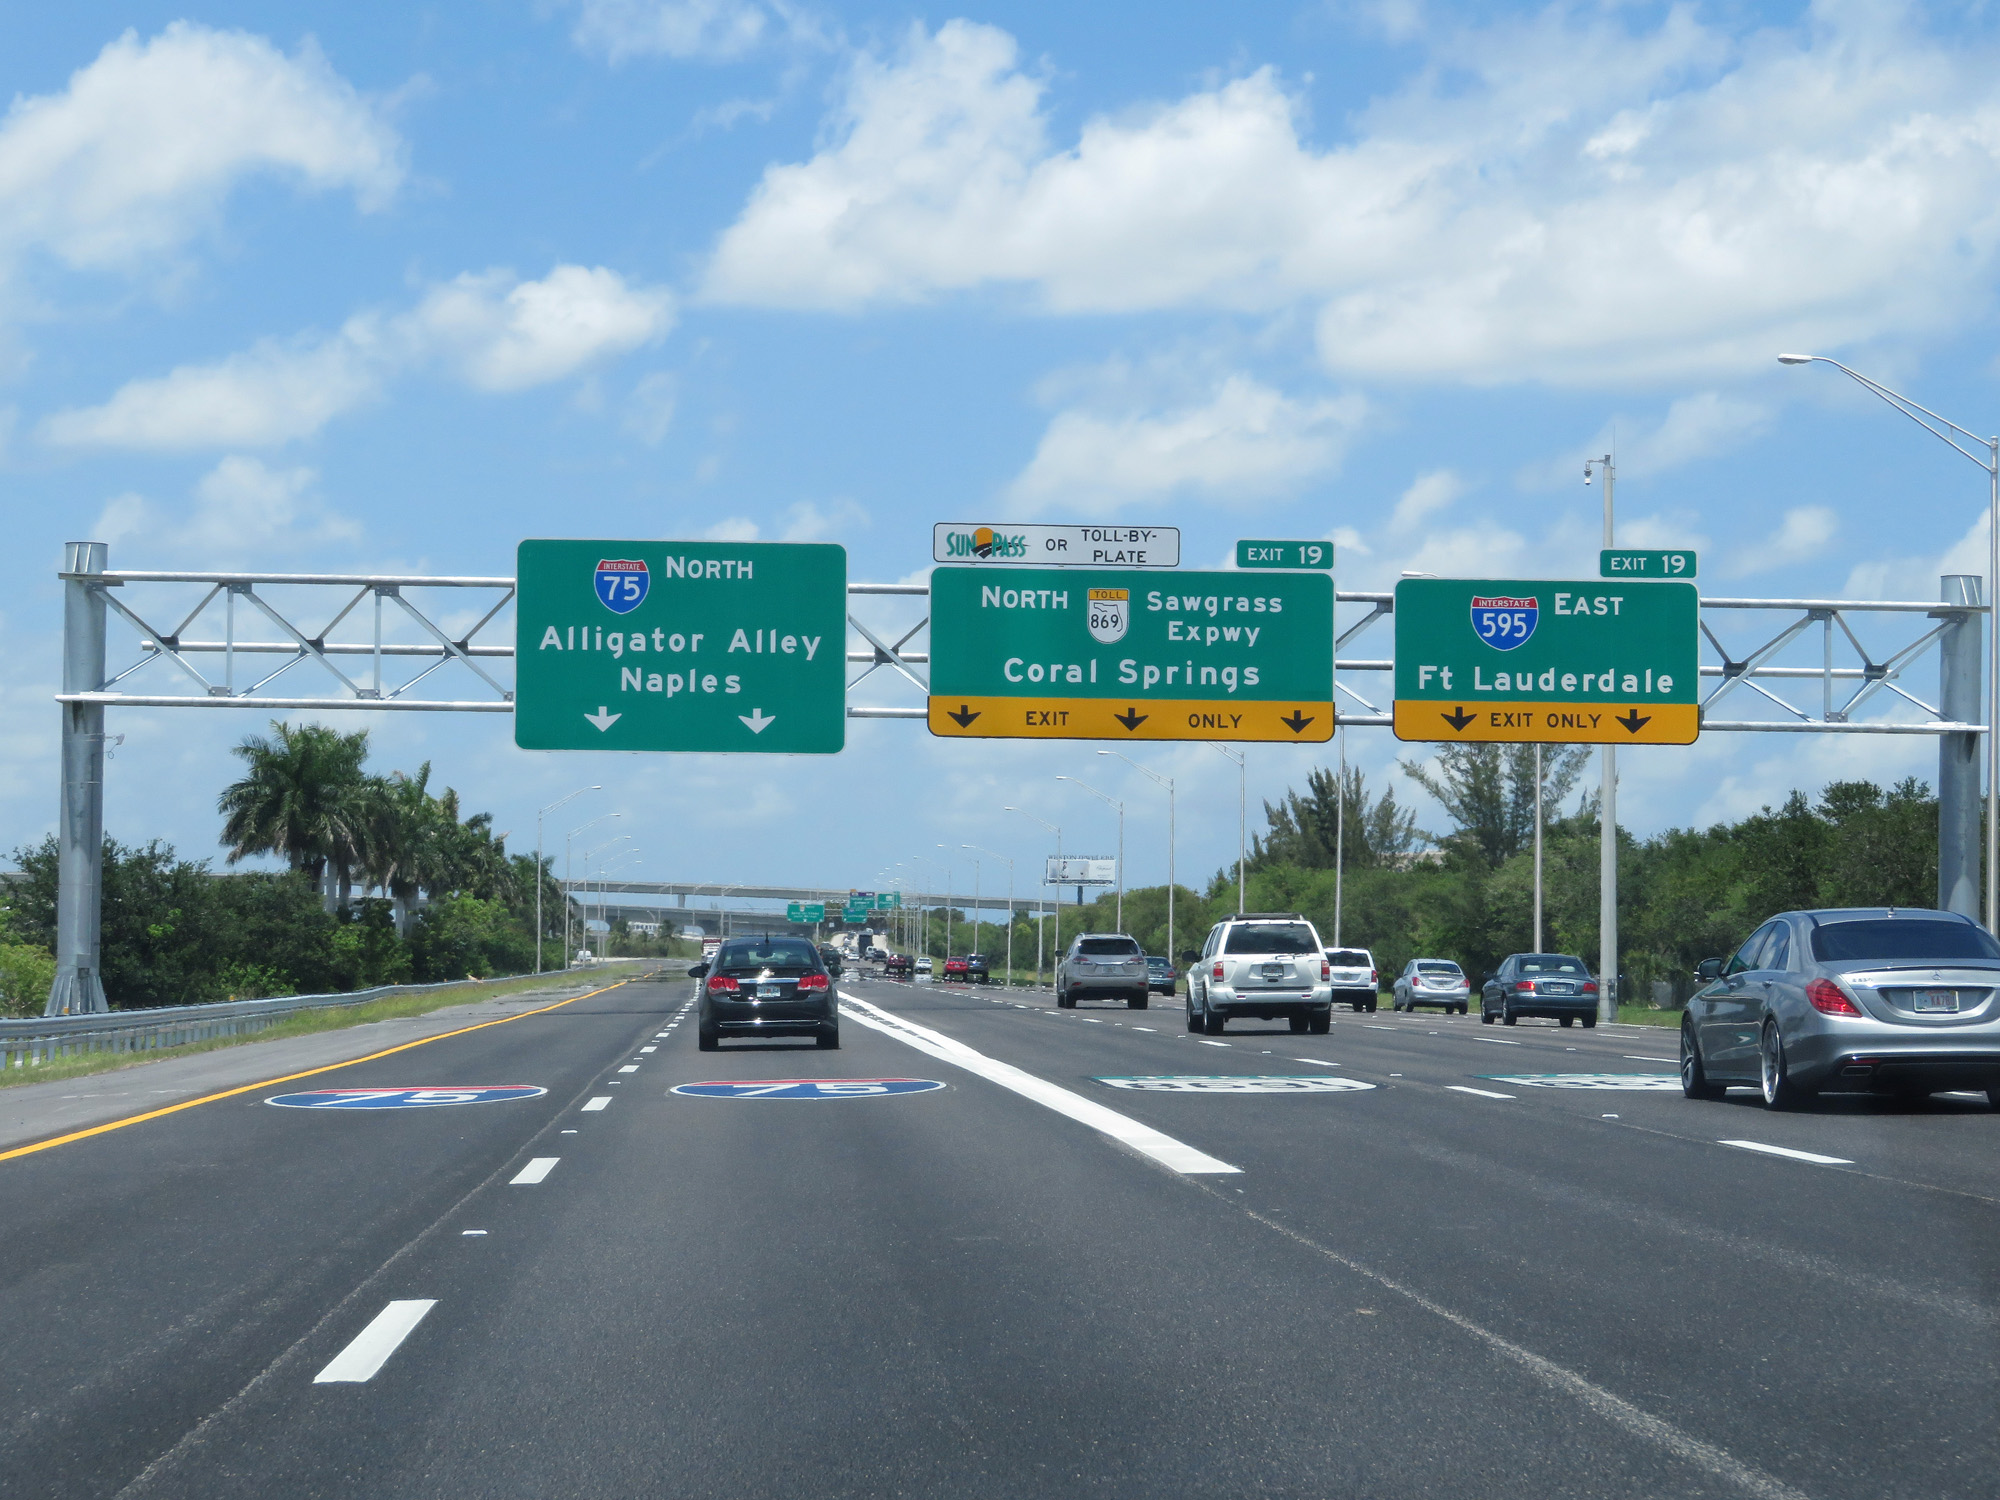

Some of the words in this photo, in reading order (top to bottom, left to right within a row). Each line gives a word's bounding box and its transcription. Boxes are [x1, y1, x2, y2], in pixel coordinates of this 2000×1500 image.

[1046, 538, 1068, 552] OR
[1081, 529, 1158, 545] TOLL-BY-
[1093, 550, 1147, 564] PLATE
[1247, 547, 1284, 561] EXIT
[1299, 546, 1322, 565] 19
[1611, 557, 1647, 570] EXIT
[1662, 555, 1686, 573] 19
[603, 562, 641, 571] INTERSTATE
[666, 556, 753, 579] NORTH
[603, 577, 640, 601] 75
[982, 586, 1068, 609] NORTH
[1094, 590, 1123, 599] TOLL
[1147, 591, 1283, 617] Sawgrass
[1478, 599, 1530, 608] INTERSTATE
[1555, 593, 1623, 615] EAST
[1090, 614, 1119, 629] 869
[1482, 613, 1527, 638] 595
[539, 625, 704, 659] Alligator
[728, 629, 821, 661] Alley
[1168, 621, 1260, 647] Expwy
[621, 667, 741, 698] Naples
[1004, 658, 1097, 683] Coral
[1119, 659, 1260, 693] Springs
[1419, 665, 1453, 690] Ft
[1474, 666, 1674, 693] Lauderdale
[1025, 711, 1069, 726] EXIT
[1189, 713, 1242, 729] ONLY
[1491, 713, 1533, 727] EXIT
[1548, 713, 1602, 729] ONLY
[311, 1091, 487, 1105] 75
[733, 1083, 888, 1096] 75
